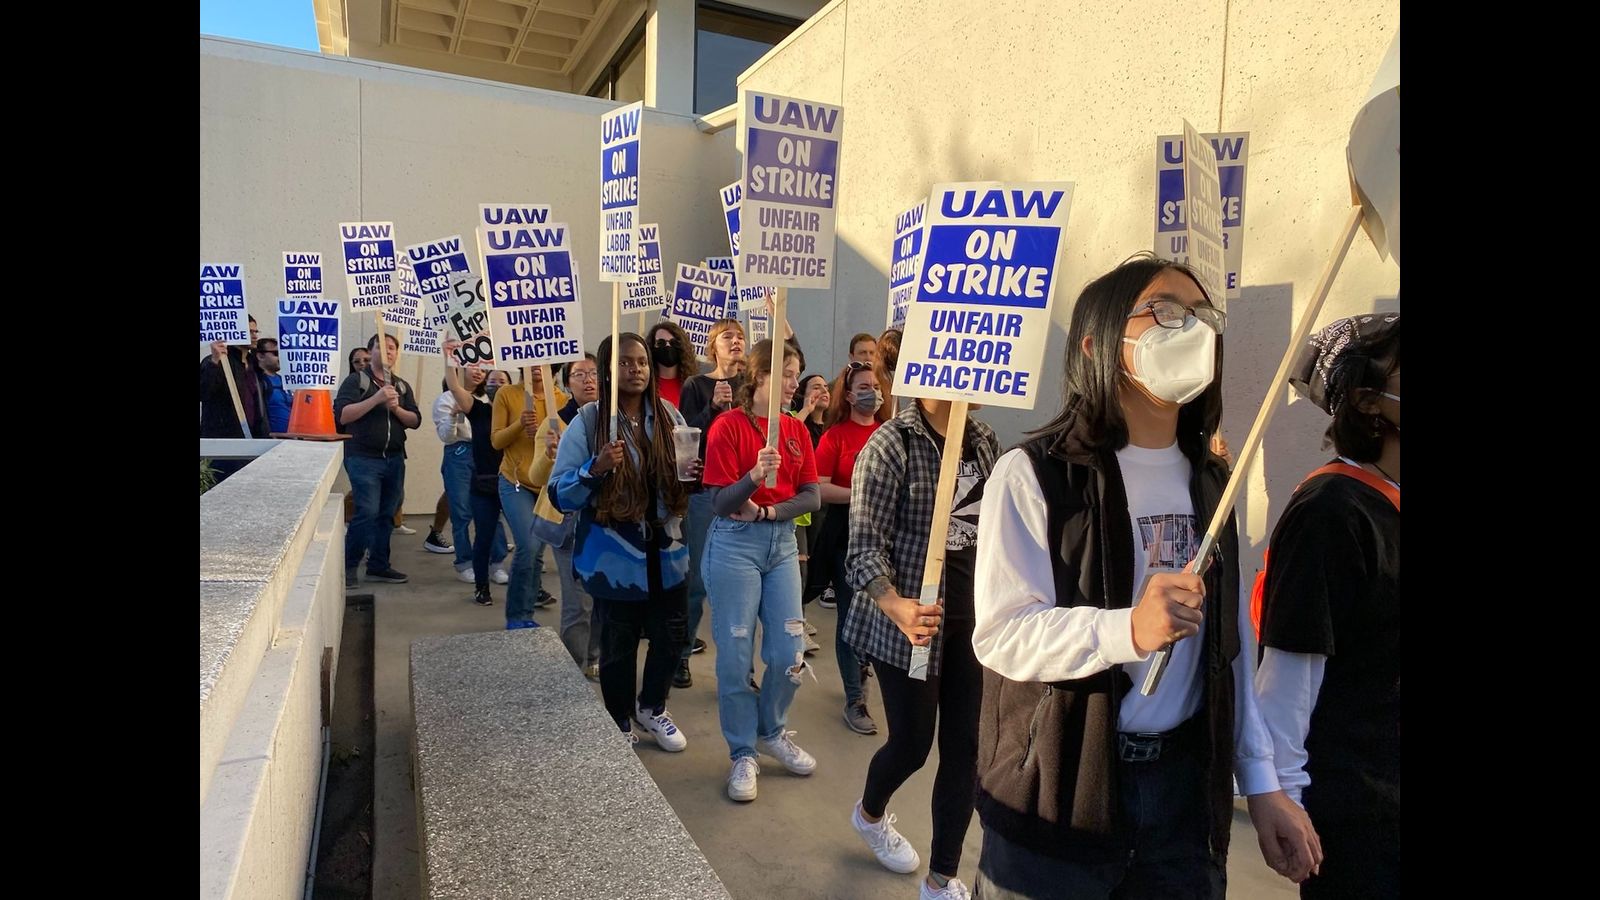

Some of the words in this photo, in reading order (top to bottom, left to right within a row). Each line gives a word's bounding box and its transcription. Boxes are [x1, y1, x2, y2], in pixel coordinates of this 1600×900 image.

[755, 95, 839, 133] UAW
[603, 108, 641, 145] UAW
[777, 137, 812, 168] ON
[1164, 138, 1244, 164] UW
[611, 149, 626, 176] ON
[602, 176, 638, 205] STRIKE
[750, 164, 834, 200] STRIKE
[1200, 172, 1213, 204] ON
[724, 185, 741, 206] UA
[940, 190, 1064, 219] UAW
[484, 208, 549, 225] UAW
[606, 211, 632, 231] UNFAIR
[759, 207, 820, 232] UNFAIR
[896, 202, 925, 235] UAW
[1191, 196, 1222, 238] STRIKE
[342, 225, 391, 239] UAW
[487, 228, 564, 250] UAW
[360, 243, 379, 256] ON
[408, 239, 459, 261] UAW
[606, 233, 630, 252] LABOR
[761, 231, 816, 254] LABOR
[900, 233, 913, 258] ON
[965, 229, 1017, 261] ON
[286, 254, 320, 265] UAW
[348, 257, 395, 271] STRIKE
[430, 259, 452, 275] ON
[514, 254, 546, 277] ON
[601, 255, 636, 273] PRACTICE
[745, 253, 827, 277] PRACTICE
[200, 265, 240, 278] AW
[297, 268, 311, 279] ON
[355, 273, 391, 285] UNFAIR
[681, 266, 729, 288] UAW
[923, 263, 1048, 299] STRIKE
[202, 281, 225, 294] ON
[287, 280, 321, 292] STRIKE
[358, 285, 390, 296] LABOR
[421, 276, 449, 295] STR
[494, 276, 571, 302] STRIKE
[629, 286, 656, 298] LABOR
[691, 287, 712, 303] ON
[200, 295, 242, 307] TRIKE
[279, 301, 339, 315] UAW
[352, 294, 399, 308] PRACTICE
[623, 295, 664, 309] PRACTICE
[675, 297, 724, 319] STRIKE
[506, 307, 566, 325] UNFAIR
[929, 310, 1023, 337] UNFAIR
[296, 319, 319, 333] ON
[409, 329, 438, 338] UNFAIR
[512, 325, 565, 343] LABOR
[200, 331, 247, 342] RACTICE
[281, 333, 337, 349] STRIKE
[410, 338, 436, 346] LABOR
[287, 352, 330, 362] UNFAIR
[403, 344, 441, 354] PRACTICE
[501, 340, 579, 361] PRACTICE
[927, 337, 1013, 365] LABOR
[289, 363, 328, 373] LABOR
[285, 375, 337, 385] PRACTICE
[903, 362, 1029, 396] PRACTICE
